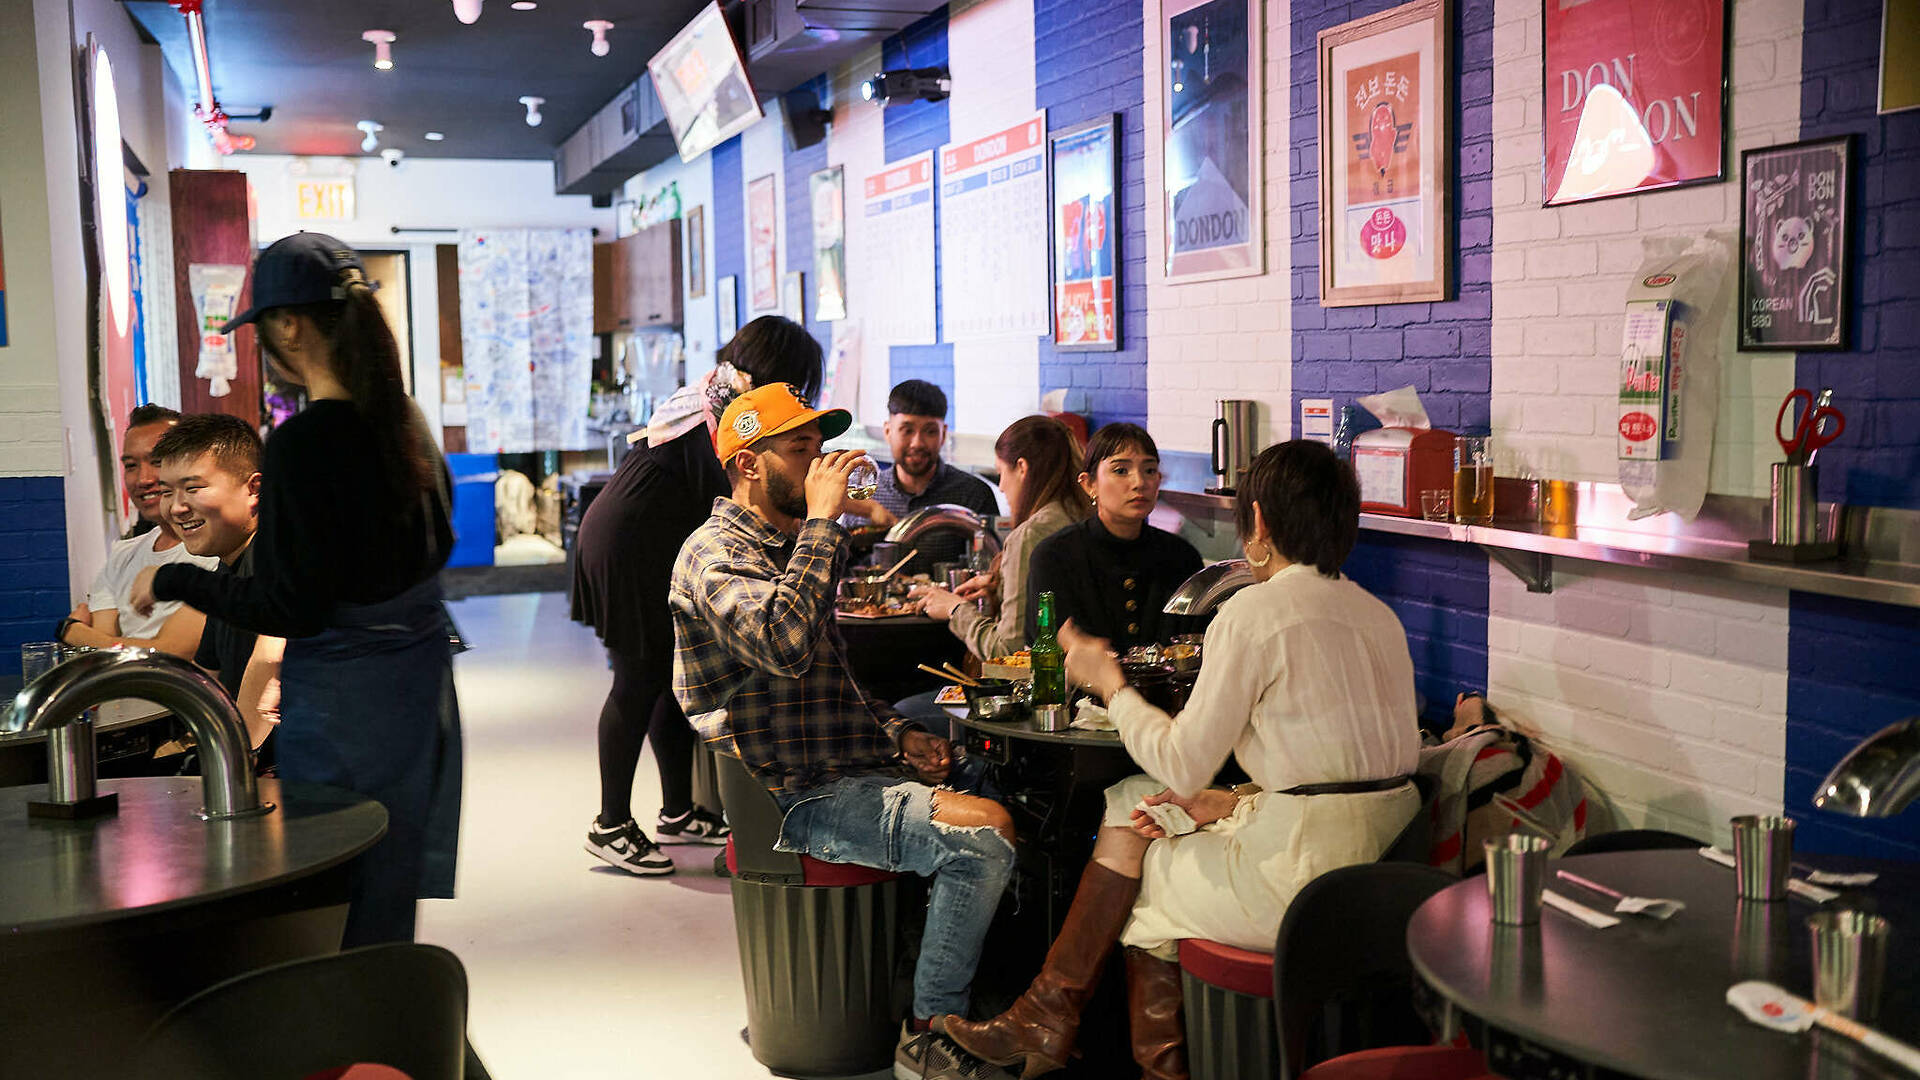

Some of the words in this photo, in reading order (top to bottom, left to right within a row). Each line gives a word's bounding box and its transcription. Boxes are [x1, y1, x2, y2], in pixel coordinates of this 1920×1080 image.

[1643, 91, 1701, 145] ON
[1808, 169, 1835, 187] DON
[298, 183, 345, 217] EXIT
[1808, 184, 1835, 201] DON
[1177, 207, 1246, 247] DONDON
[1752, 297, 1793, 312] KOREAN
[1752, 314, 1772, 328] BBQ
